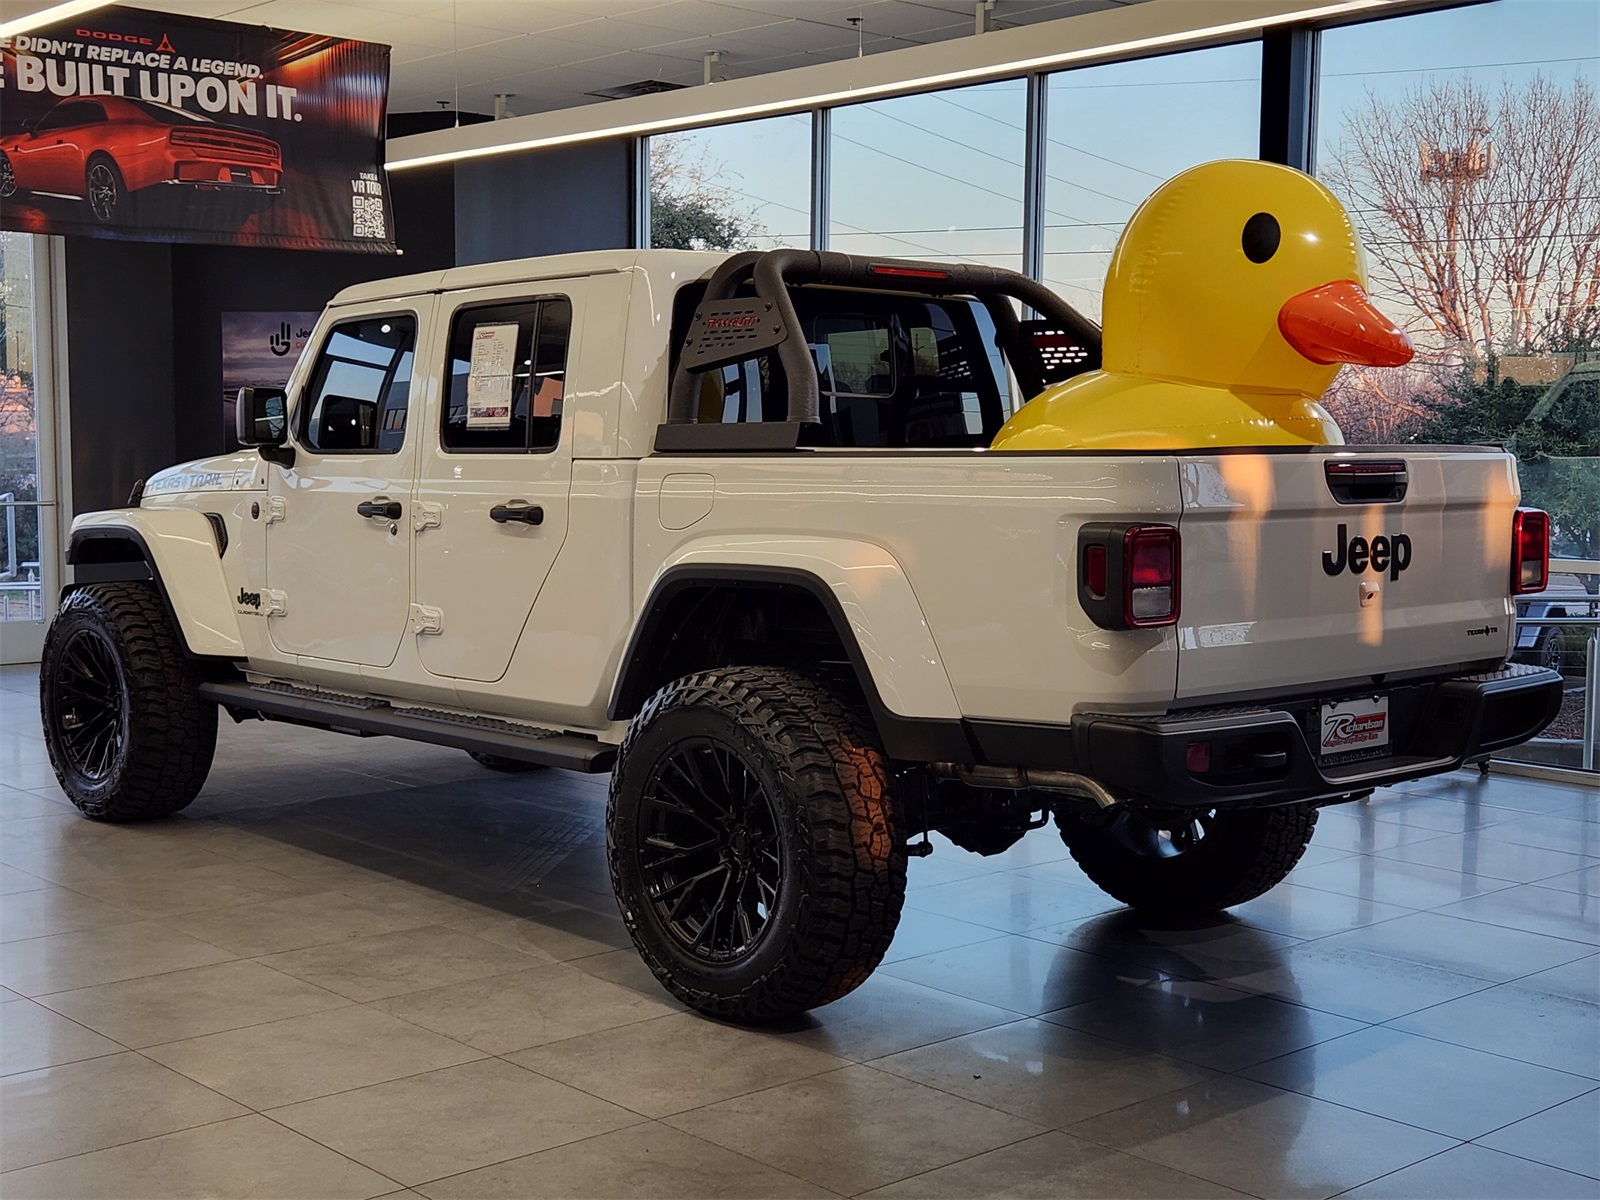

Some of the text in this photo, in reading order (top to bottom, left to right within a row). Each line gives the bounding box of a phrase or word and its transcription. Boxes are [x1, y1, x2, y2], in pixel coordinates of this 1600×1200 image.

[76, 29, 153, 45] DODGE
[16, 35, 84, 57] DIDN'T
[87, 45, 171, 68] REPLACE
[173, 56, 188, 71] A
[191, 58, 264, 79] LEGEND.
[16, 54, 130, 96] BUILT
[140, 70, 257, 116] UPON
[266, 84, 303, 122] IT.
[351, 180, 382, 196] VR TOUR
[296, 328, 311, 338] Je
[1322, 524, 1412, 582] Jeep
[237, 587, 260, 610] Jeep
[1322, 712, 1384, 747] Richardson
